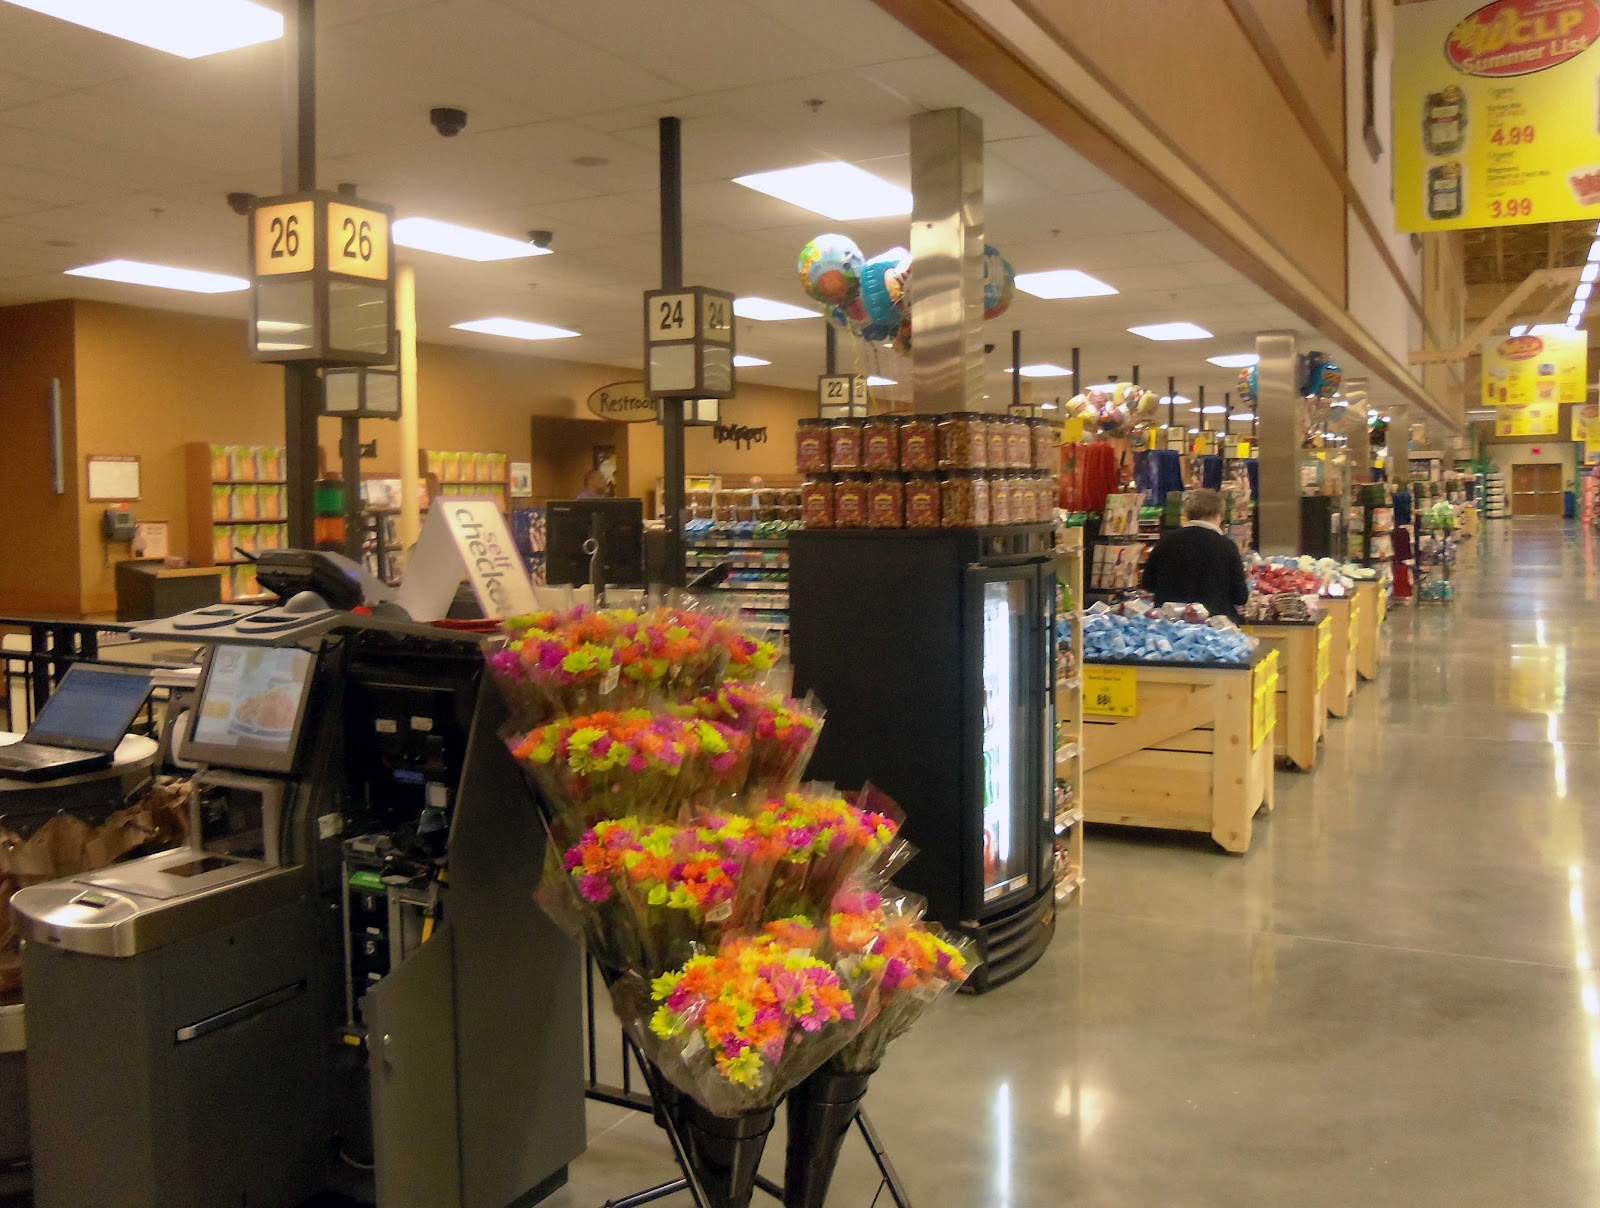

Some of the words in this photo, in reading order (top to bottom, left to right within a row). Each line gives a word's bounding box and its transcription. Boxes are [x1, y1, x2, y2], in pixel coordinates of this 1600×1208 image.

[1461, 46, 1546, 73] Summer
[1551, 35, 1588, 56] List
[1491, 125, 1536, 145] 4.99
[1491, 198, 1532, 219] 3.99
[270, 215, 299, 259] 26
[342, 217, 372, 262] 26
[661, 300, 684, 330] 24
[708, 301, 724, 330] 24
[828, 381, 843, 398] 22
[484, 532, 514, 570] self
